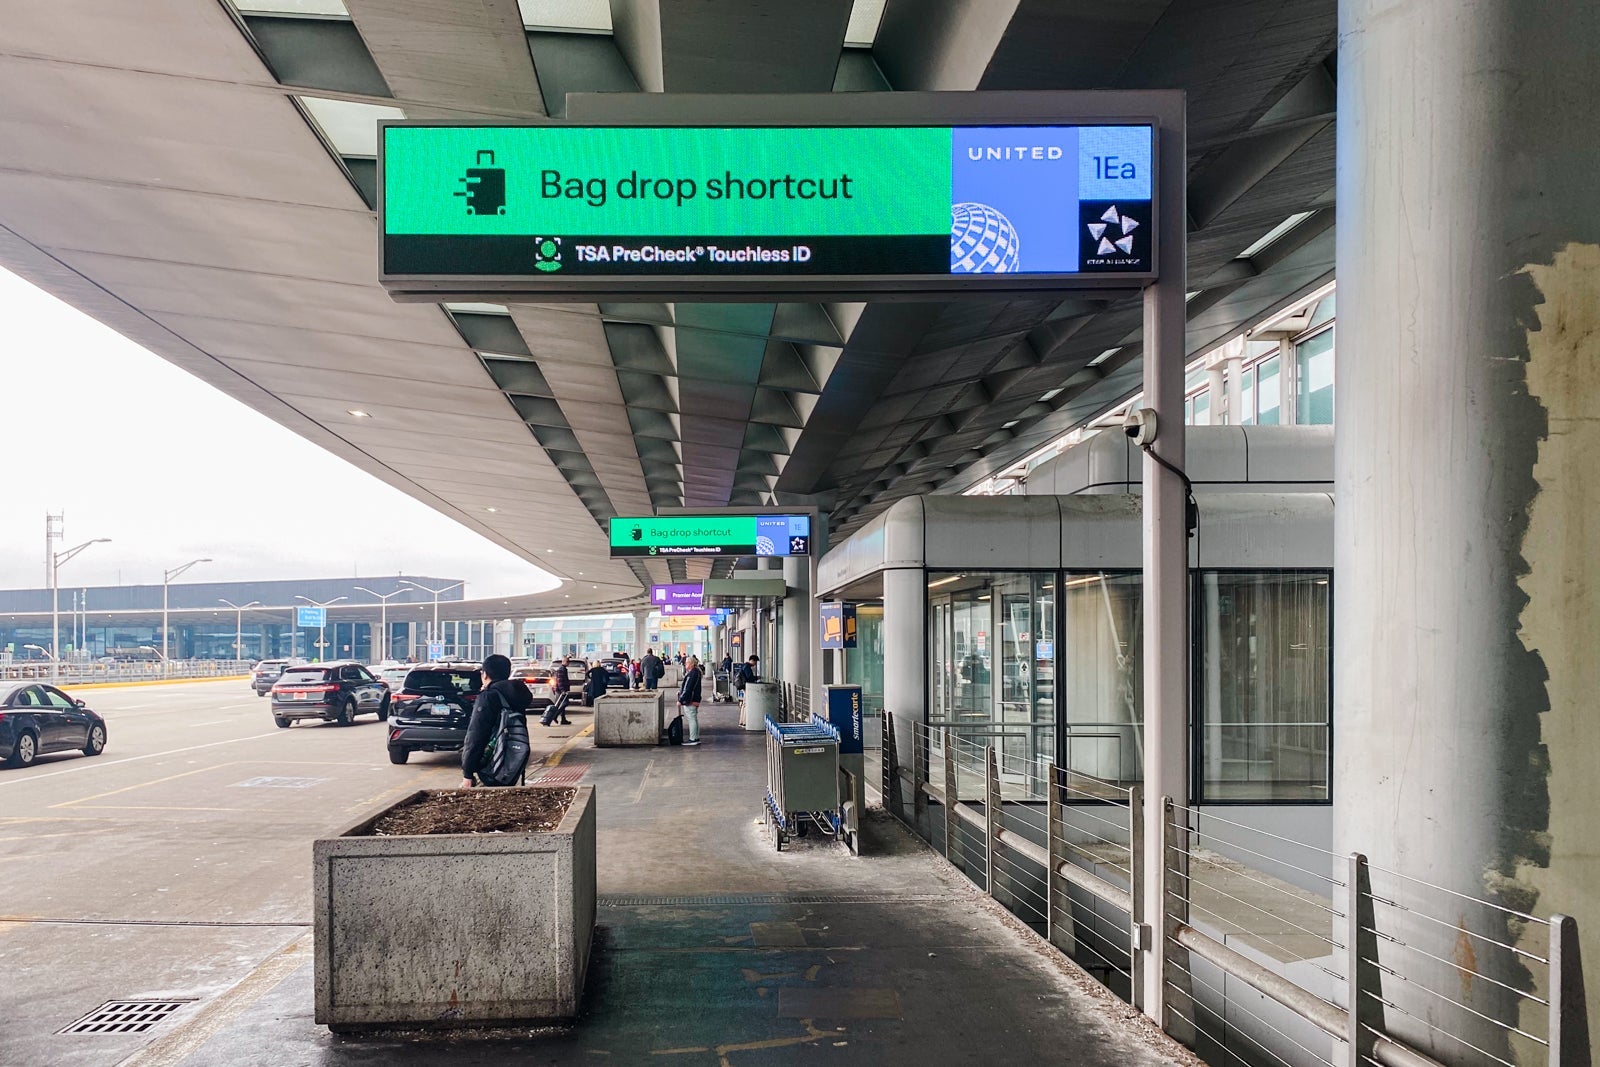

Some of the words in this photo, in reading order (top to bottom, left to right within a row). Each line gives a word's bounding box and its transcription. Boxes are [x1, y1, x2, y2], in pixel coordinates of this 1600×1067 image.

[968, 146, 1063, 161] UNITED
[1093, 155, 1136, 180] 1Ea
[541, 170, 606, 207] Bag
[617, 170, 697, 207] drop
[706, 171, 853, 200] shortcut
[575, 245, 611, 262] TSA
[707, 245, 790, 262] Touchless
[792, 245, 811, 262] ID
[650, 528, 669, 538] Bag
[669, 527, 692, 539] drop
[693, 527, 732, 537] shortcut
